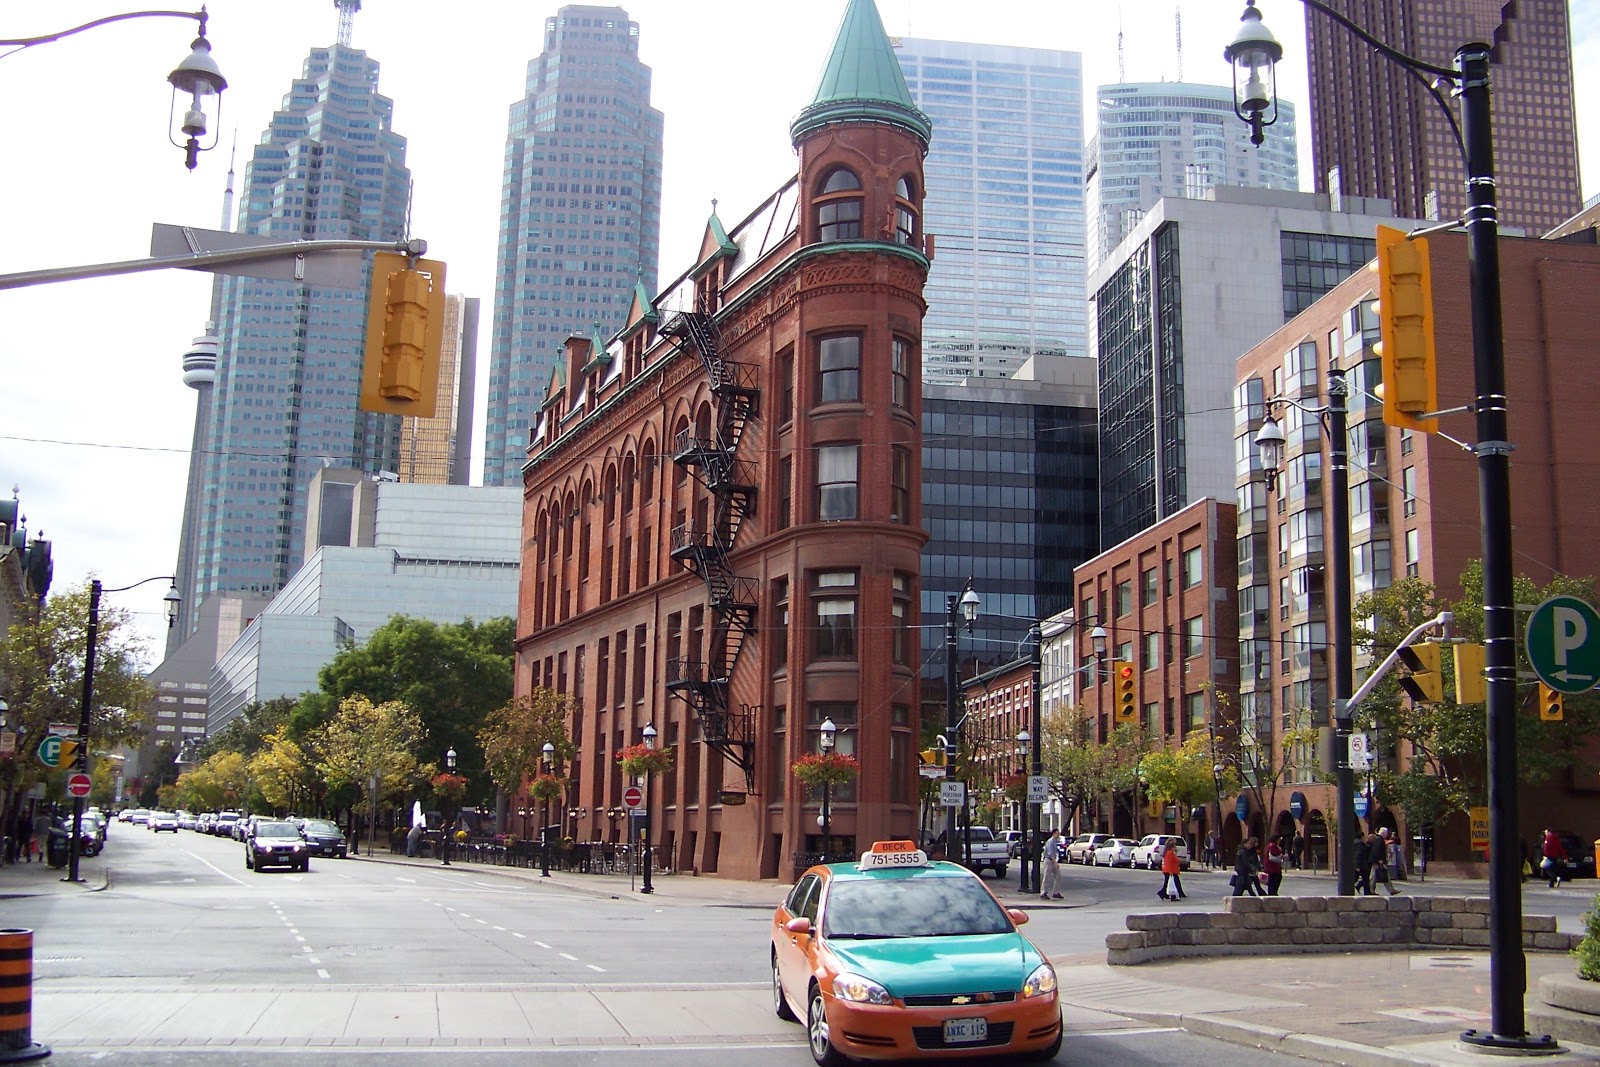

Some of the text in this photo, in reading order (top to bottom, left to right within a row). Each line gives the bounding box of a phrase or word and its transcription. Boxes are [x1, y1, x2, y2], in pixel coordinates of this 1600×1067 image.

[1553, 606, 1587, 665] P
[882, 842, 906, 851] BECK
[871, 853, 920, 865] 751-5555
[971, 1024, 985, 1035] 115
